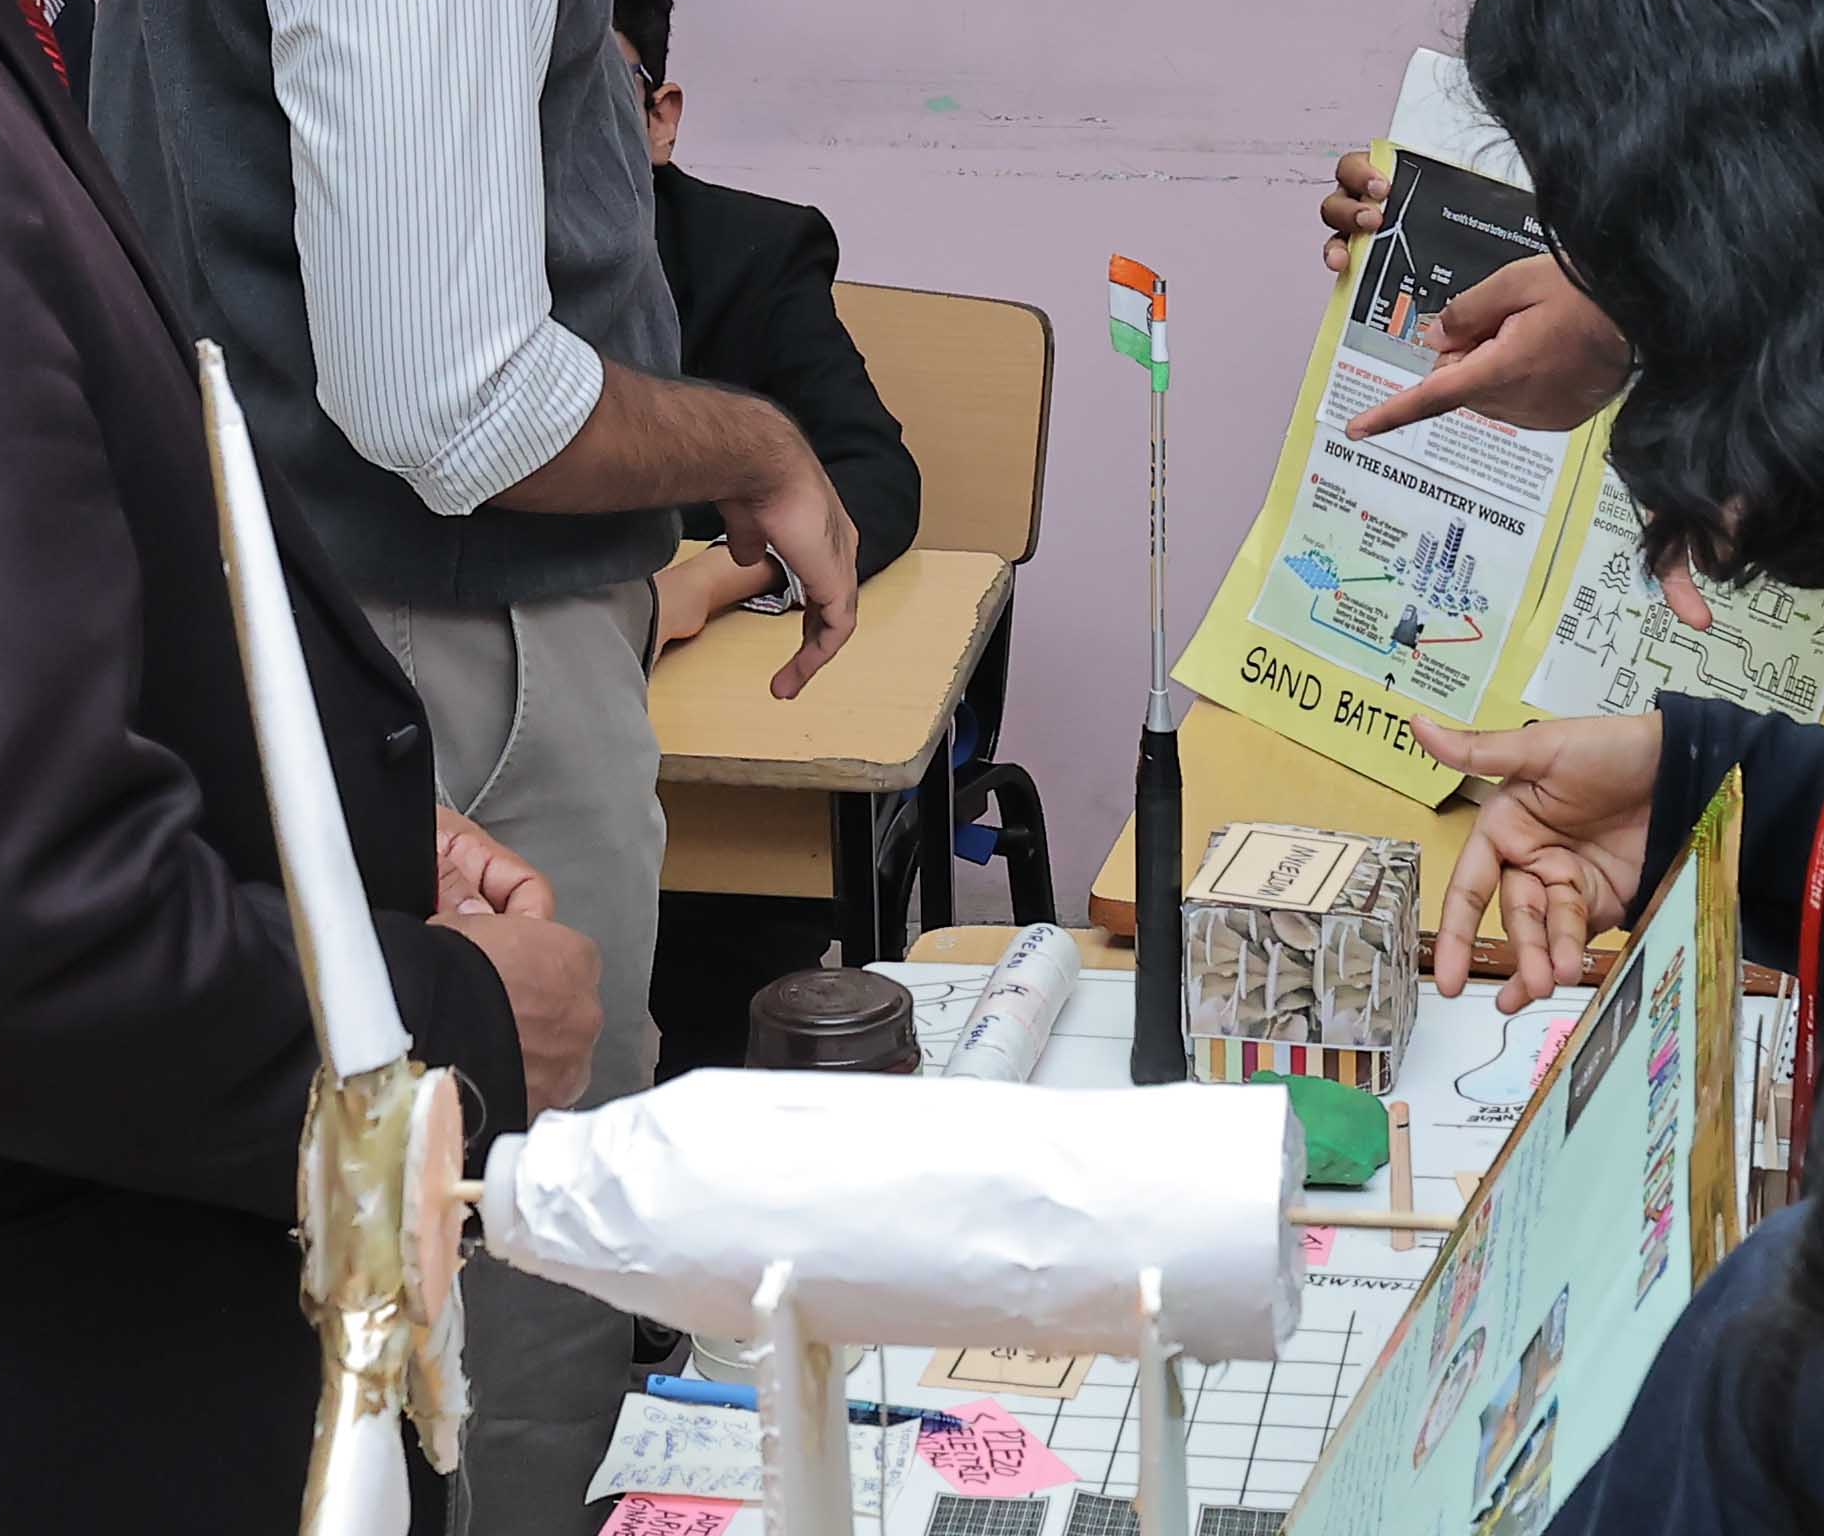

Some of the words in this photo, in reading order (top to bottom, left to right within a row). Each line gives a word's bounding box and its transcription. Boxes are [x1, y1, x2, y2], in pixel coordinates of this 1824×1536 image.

[1324, 439, 1355, 463] HOW
[1354, 451, 1382, 475] THE
[1380, 463, 1419, 491] SAND
[1417, 478, 1477, 515] BATTERY
[1476, 503, 1526, 537] WORKS
[1593, 517, 1639, 545] economy
[1240, 646, 1322, 711] SAND
[1333, 690, 1440, 771] BATTE
[982, 1428, 1026, 1477] PIEZO
